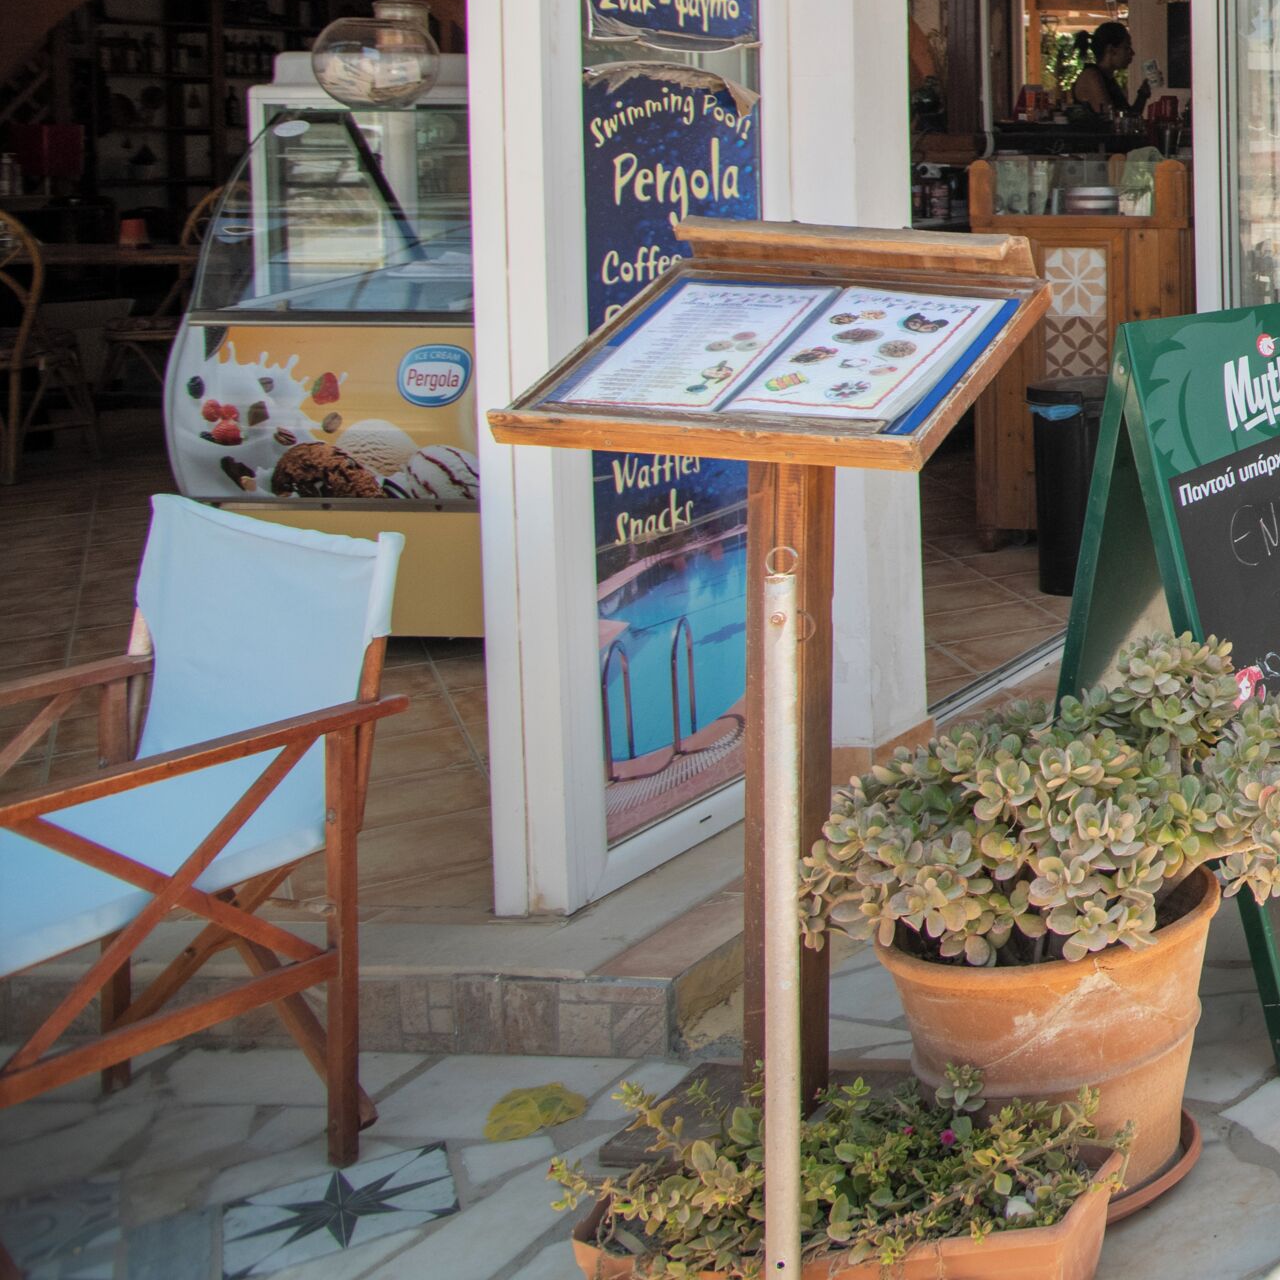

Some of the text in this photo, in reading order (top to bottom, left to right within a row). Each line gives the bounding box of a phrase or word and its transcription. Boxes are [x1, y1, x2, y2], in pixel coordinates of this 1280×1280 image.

[590, 87, 751, 148] Swimming Pool!
[613, 137, 740, 229] Pergola
[407, 368, 460, 391] Pergola
[415, 351, 461, 361] ICE CREAM
[1178, 467, 1236, 508] Παντού
[615, 488, 694, 546] Snacks
